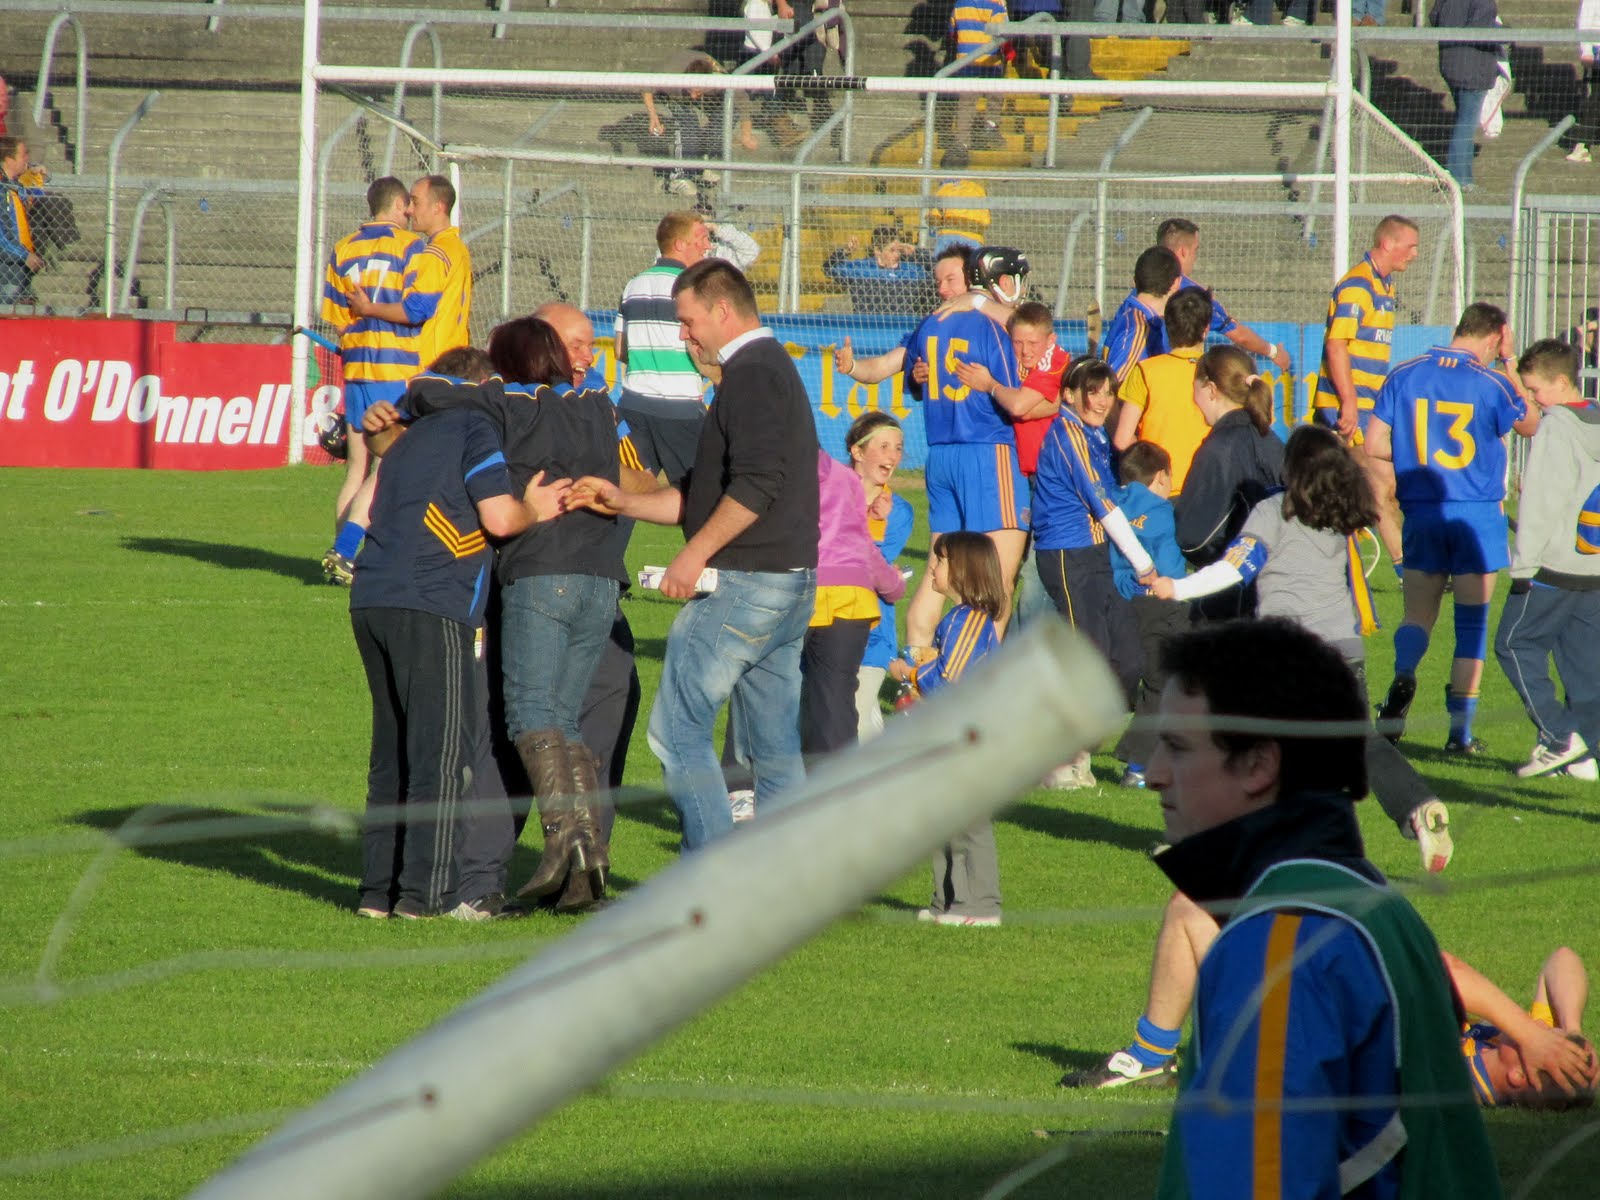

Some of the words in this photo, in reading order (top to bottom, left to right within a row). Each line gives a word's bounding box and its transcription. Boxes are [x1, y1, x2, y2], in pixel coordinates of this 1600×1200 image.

[44, 359, 292, 445] O'Donnell
[926, 335, 972, 402] 15
[1414, 398, 1476, 470] 13
